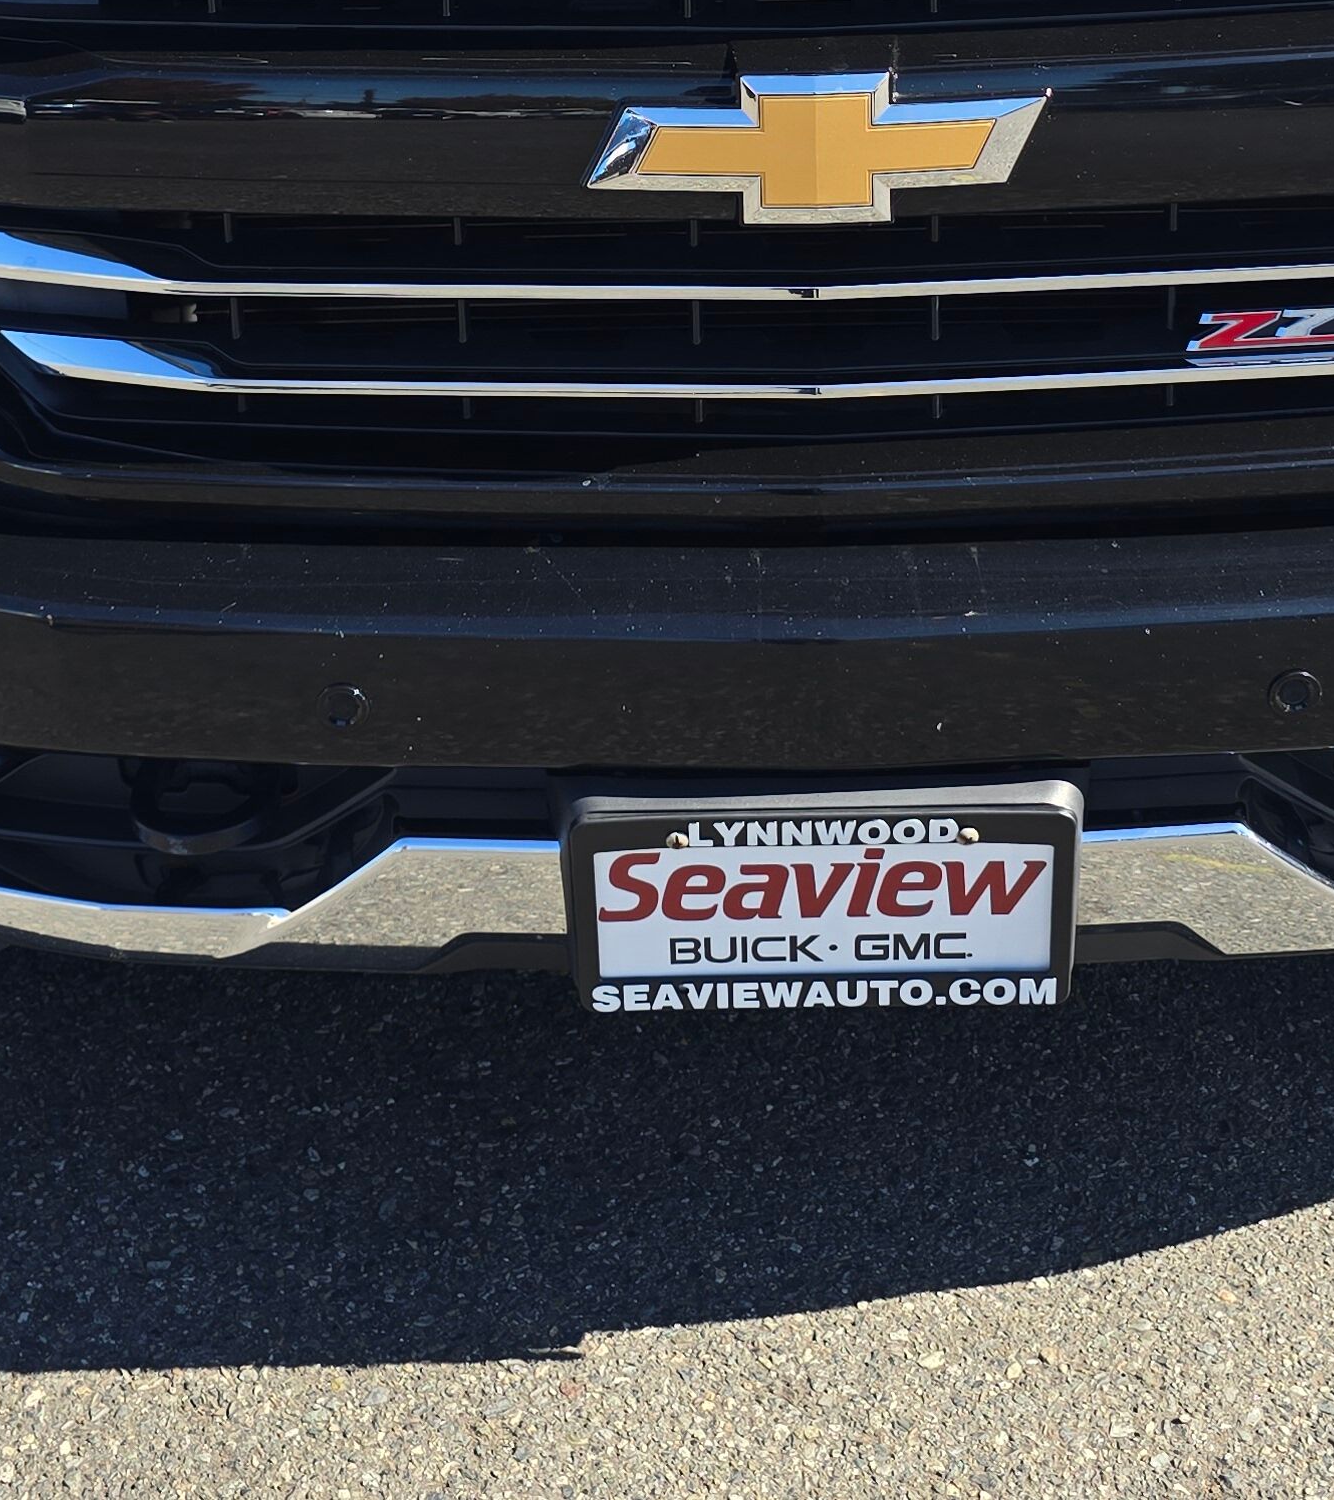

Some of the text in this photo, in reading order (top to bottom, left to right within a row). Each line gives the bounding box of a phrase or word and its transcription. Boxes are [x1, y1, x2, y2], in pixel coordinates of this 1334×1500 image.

[688, 819, 959, 846] LYNNWOOD
[598, 848, 1048, 922] Seaview
[669, 932, 969, 964] BUICK GMC
[592, 978, 1057, 1012] SEAVIEWAUTO.COM
